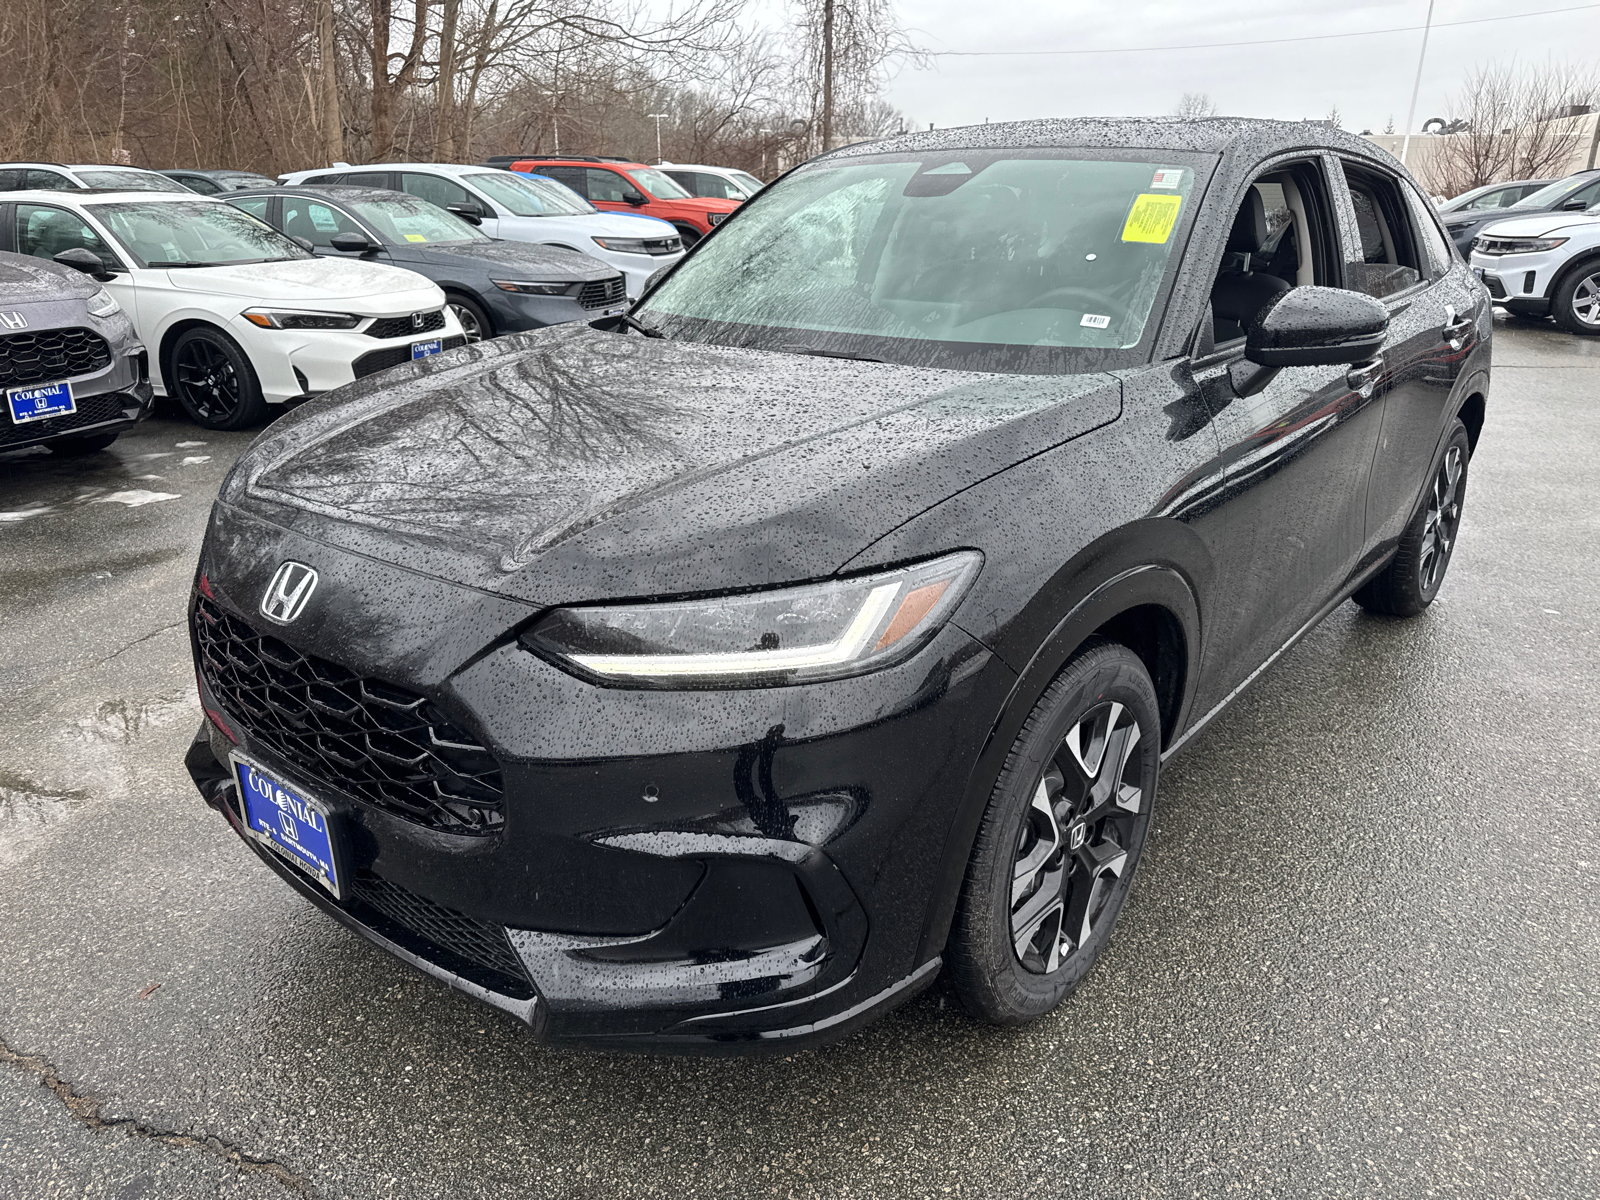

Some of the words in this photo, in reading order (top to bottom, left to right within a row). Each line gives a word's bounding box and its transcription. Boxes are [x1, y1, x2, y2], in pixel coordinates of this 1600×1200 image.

[15, 386, 63, 401] COLONIAL
[249, 772, 322, 833] COLONIAL
[270, 840, 298, 865] COLONIAL
[299, 859, 320, 881] HONDA
